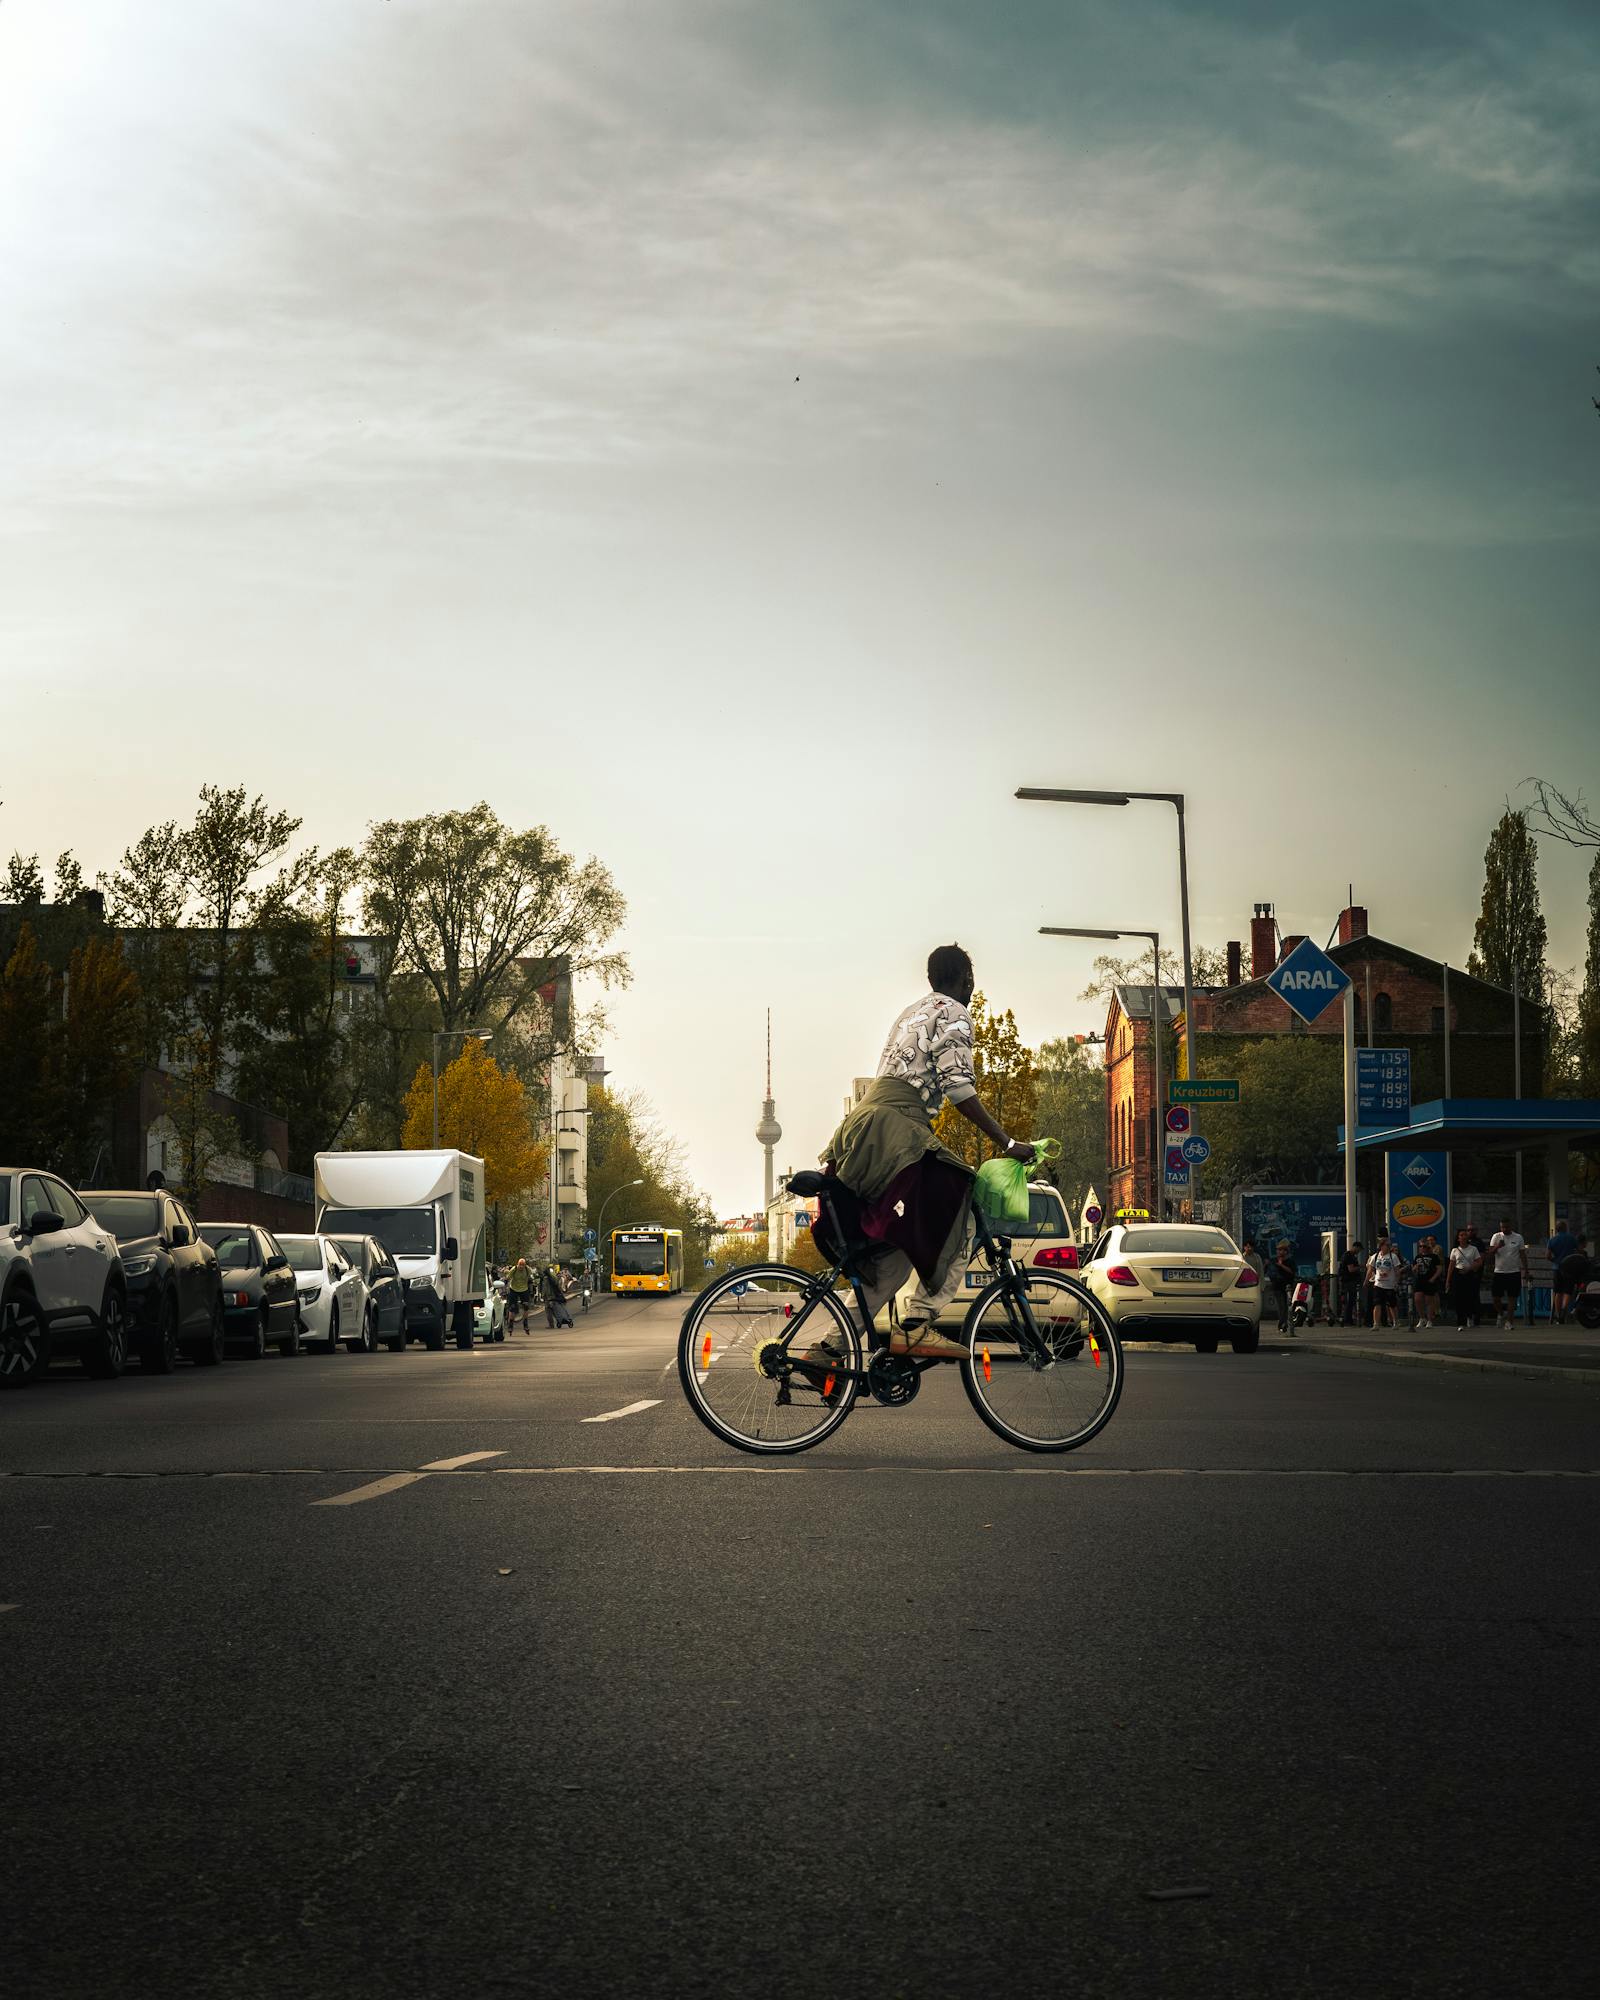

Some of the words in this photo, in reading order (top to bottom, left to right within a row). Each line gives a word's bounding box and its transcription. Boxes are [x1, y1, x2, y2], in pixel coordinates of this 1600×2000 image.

[1279, 969, 1340, 991] ARAL
[1173, 1085, 1235, 1100] Kreuzberg
[1406, 1167, 1432, 1176] ARAL
[1167, 1172, 1188, 1182] TAXI
[1124, 1209, 1145, 1217] TAXI
